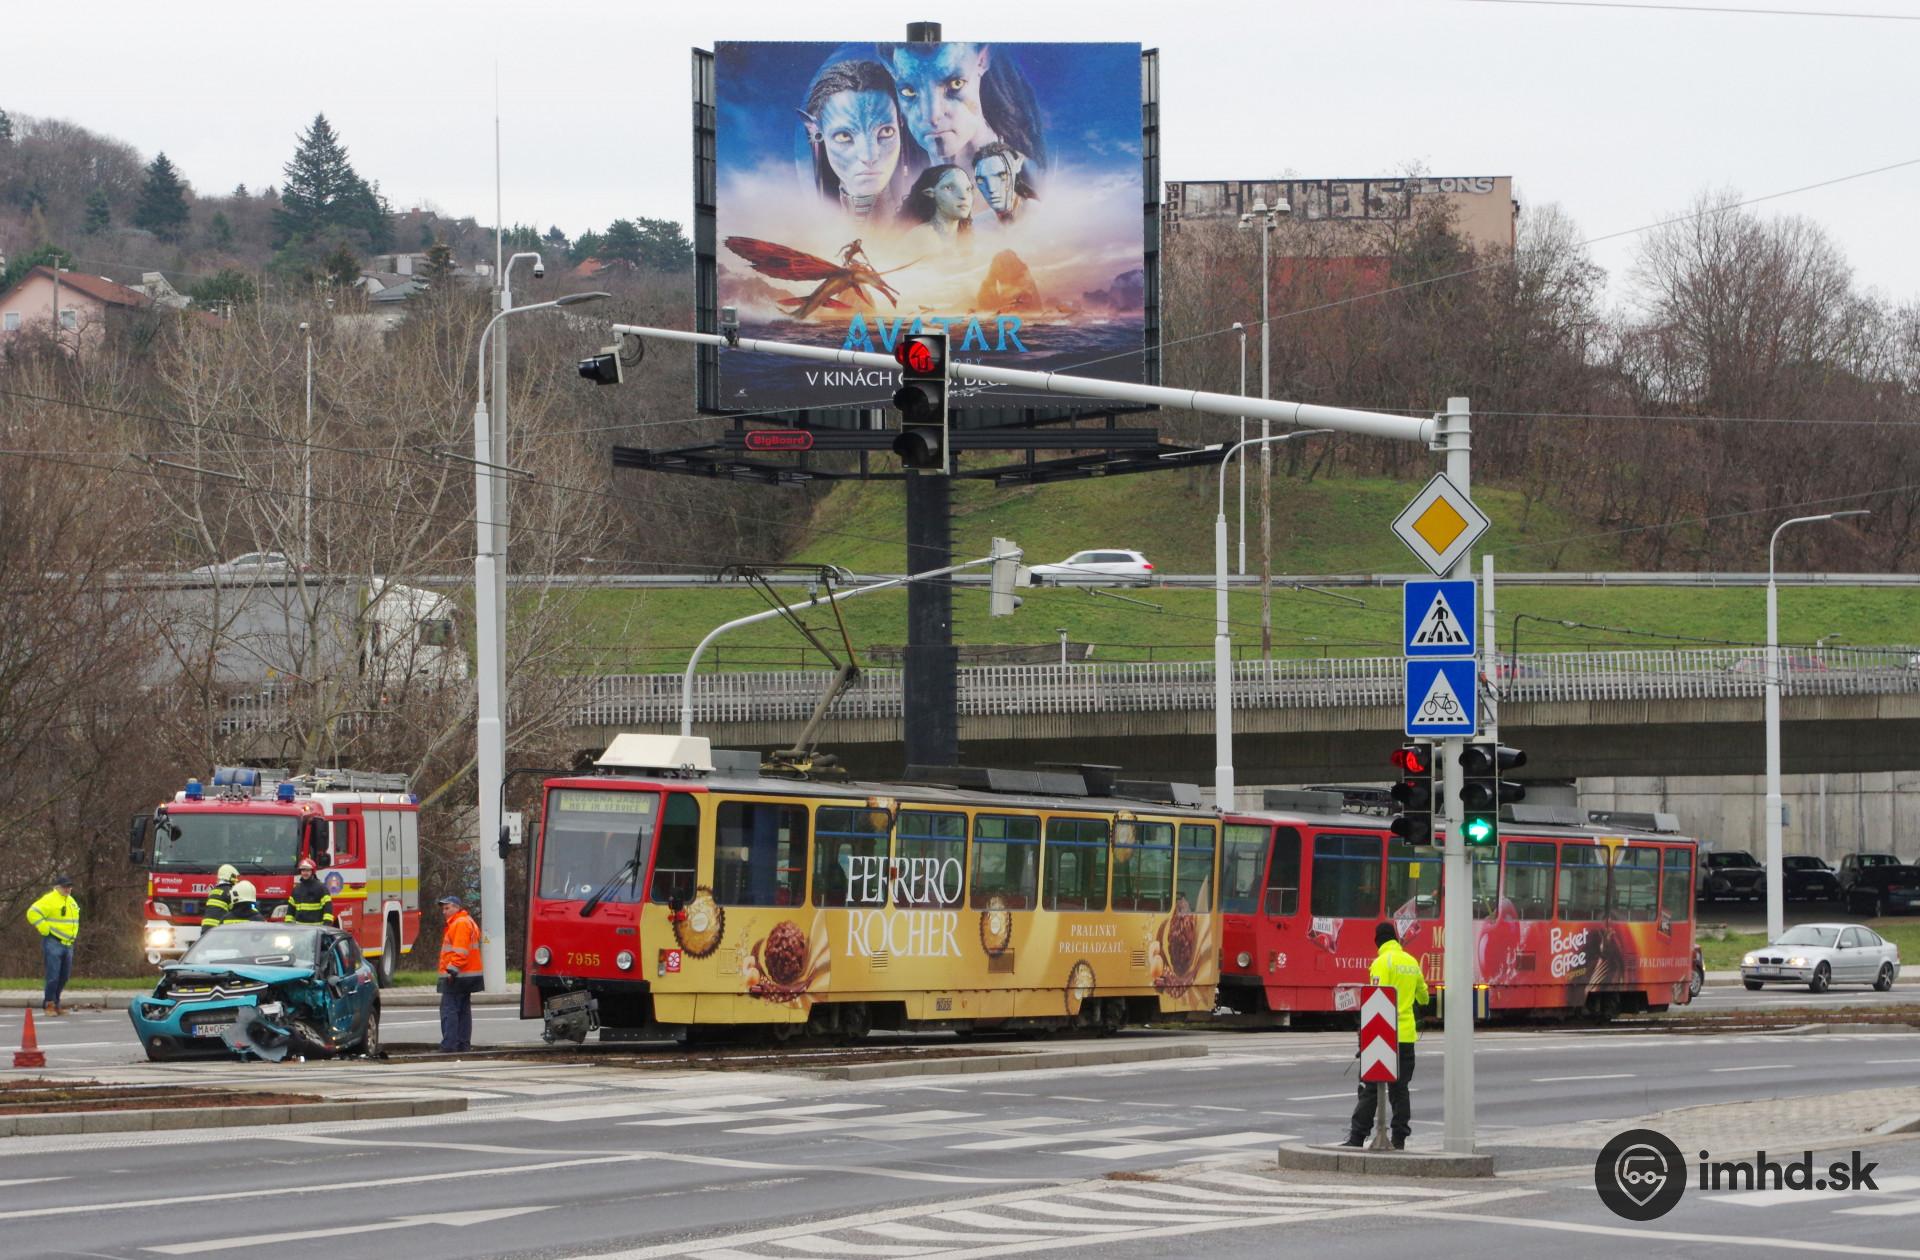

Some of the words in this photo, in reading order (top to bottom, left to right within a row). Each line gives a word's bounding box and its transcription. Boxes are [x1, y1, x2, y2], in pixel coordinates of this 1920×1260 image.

[806, 372, 819, 386] V
[824, 368, 892, 386] KINÁCH
[846, 856, 962, 903] FERRERO
[846, 910, 961, 957] ROCHER
[1071, 924, 1118, 937] PRALINKY
[1551, 928, 1588, 954] Pocket
[567, 952, 600, 966] 7955
[1551, 952, 1587, 977] Coffee
